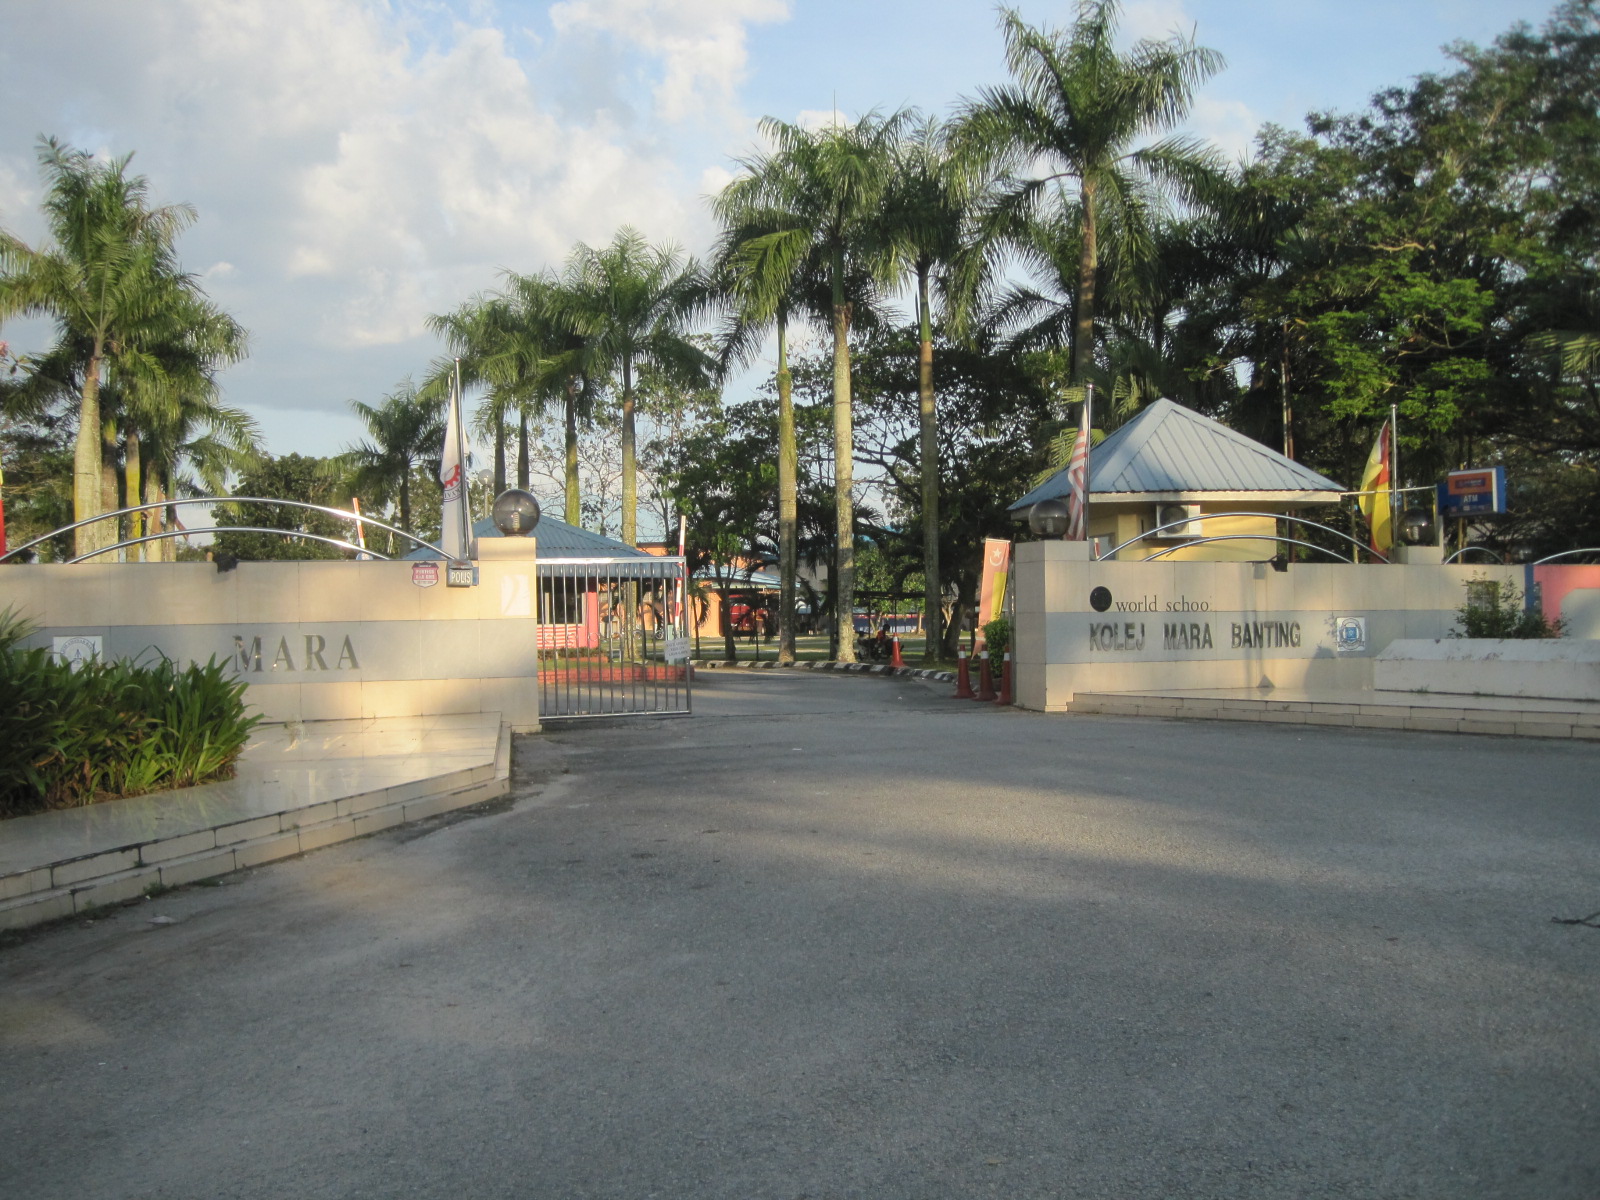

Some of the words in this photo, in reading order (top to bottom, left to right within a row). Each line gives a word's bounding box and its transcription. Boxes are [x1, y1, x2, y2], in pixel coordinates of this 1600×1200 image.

[1463, 494, 1478, 503] ATM
[450, 571, 471, 584] POLIS
[1115, 594, 1158, 613] world
[1089, 622, 1146, 652] KOLEJ
[1163, 622, 1213, 650] MARA
[1231, 620, 1301, 649] BANTING
[232, 634, 361, 672] MARA
